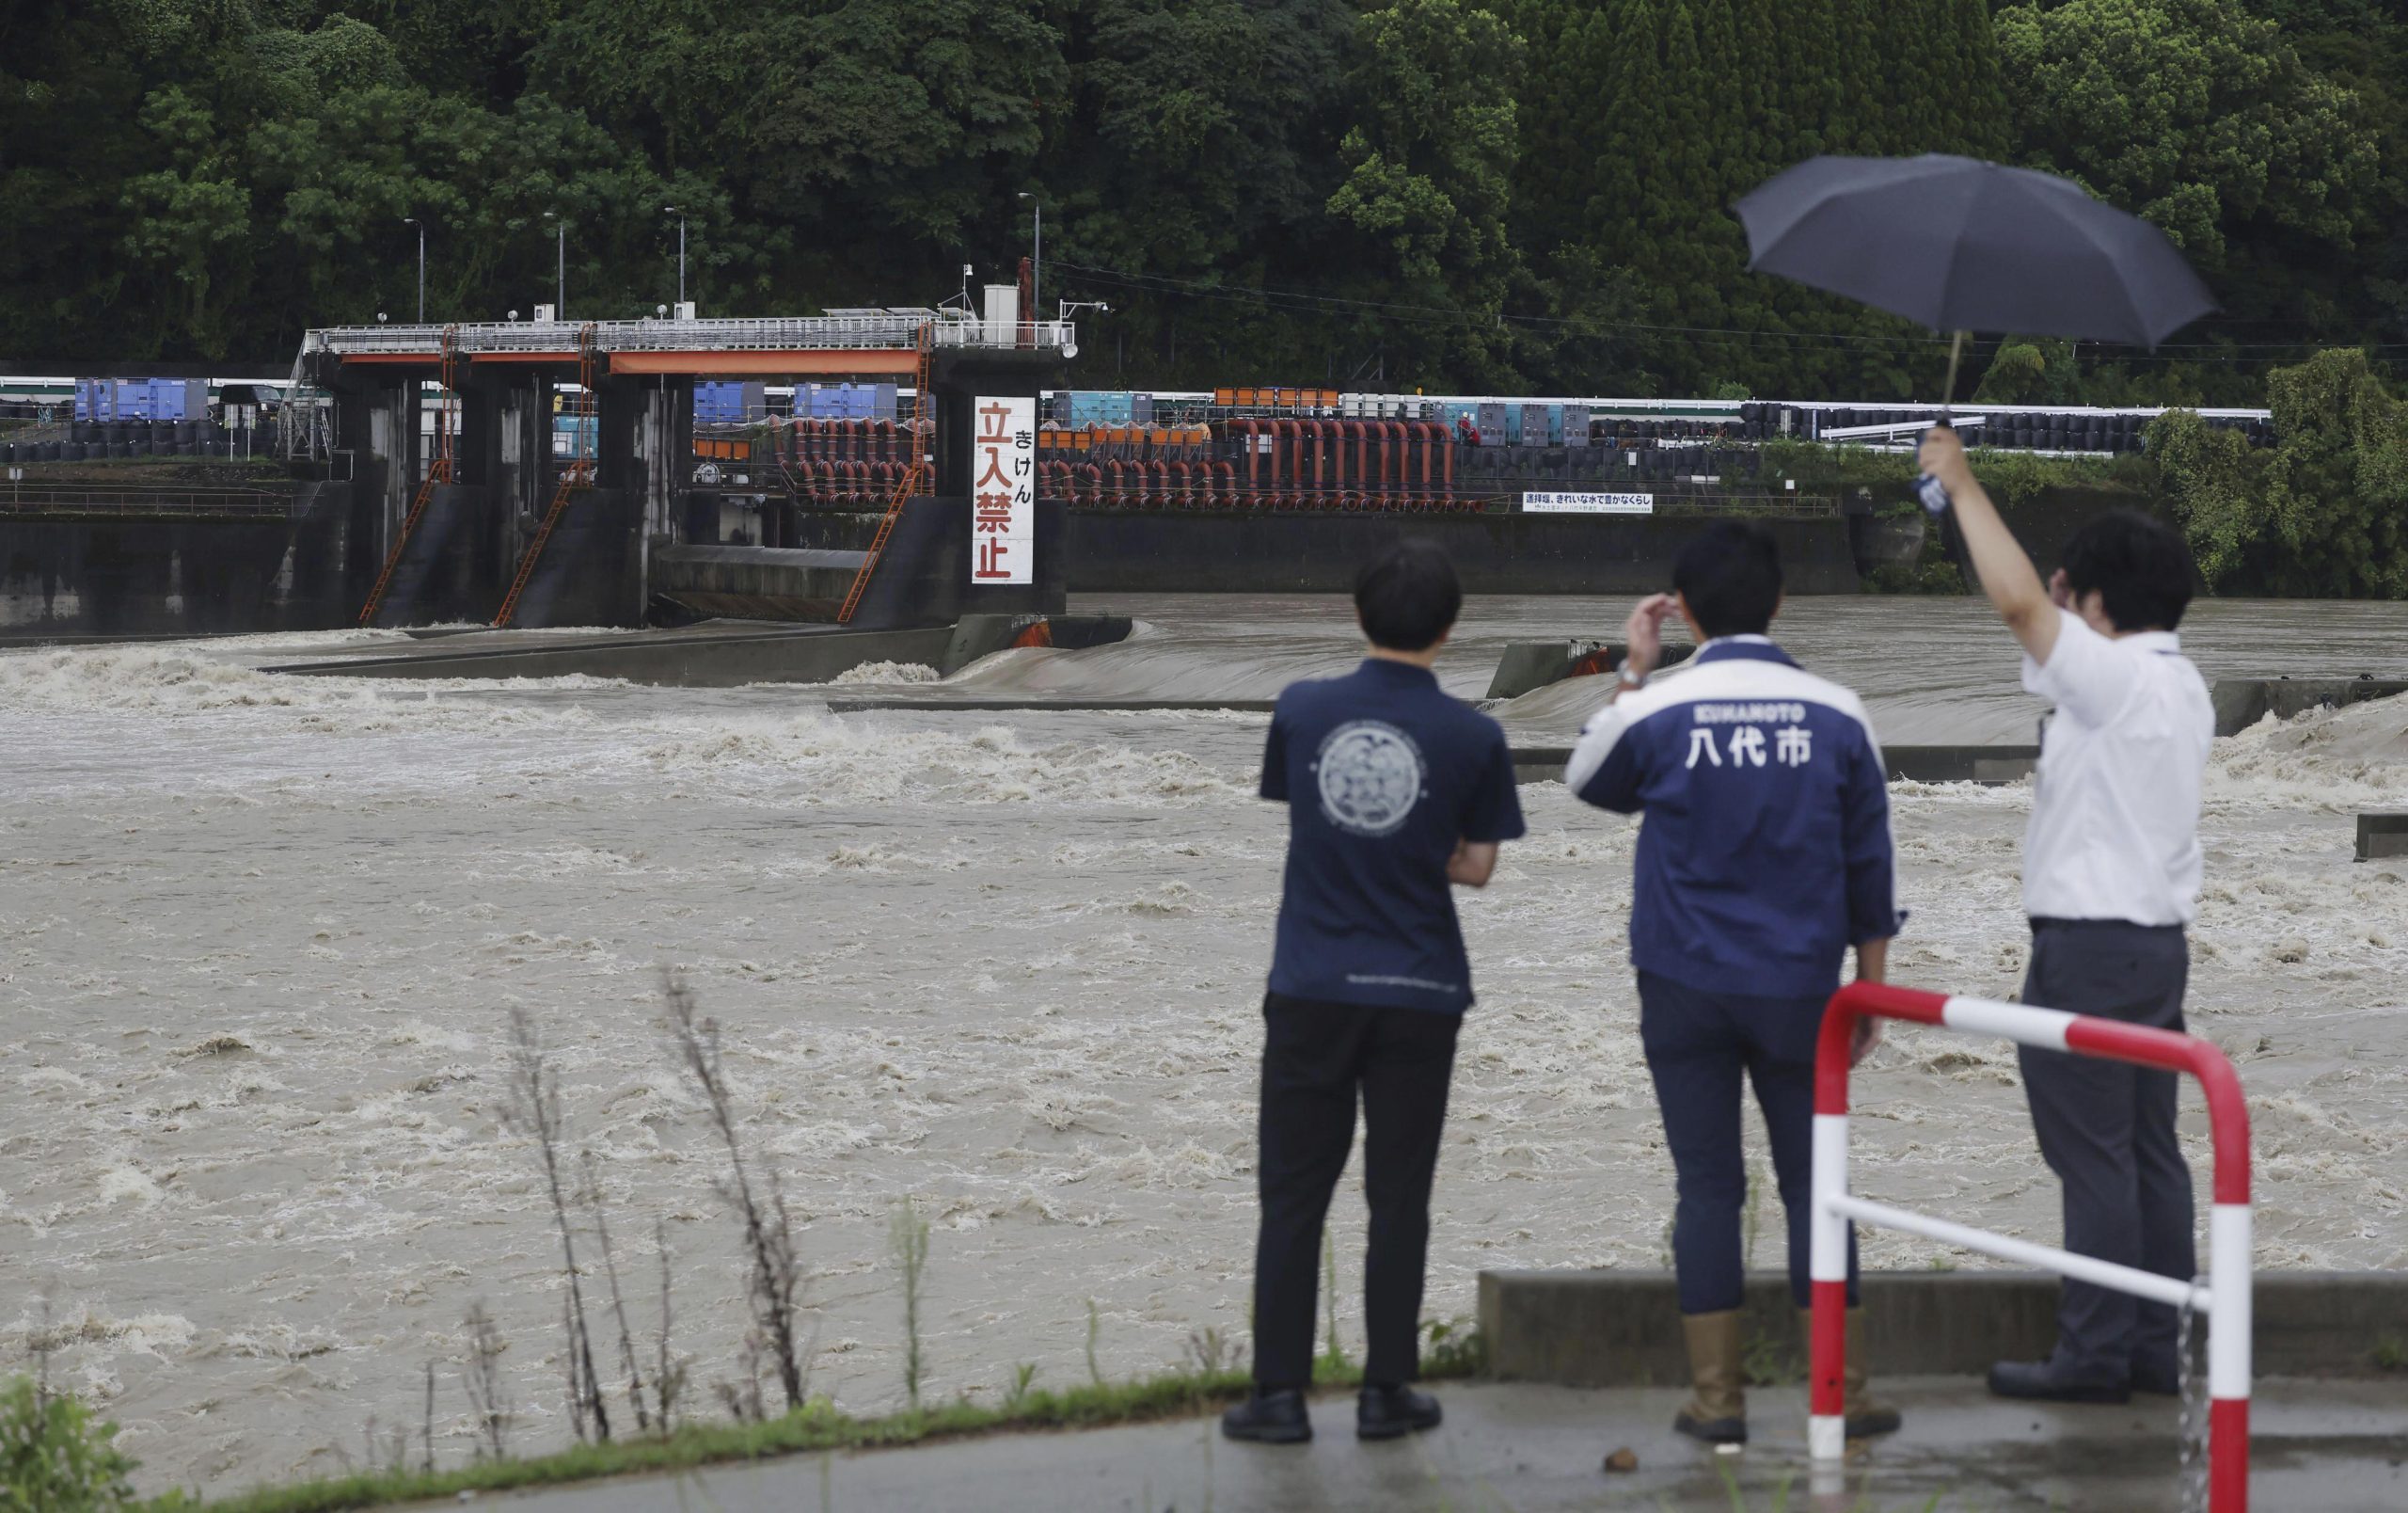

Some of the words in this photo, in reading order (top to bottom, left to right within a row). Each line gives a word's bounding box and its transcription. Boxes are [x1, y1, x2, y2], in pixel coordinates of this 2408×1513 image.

[975, 401, 1013, 578] 立入禁止
[1015, 429, 1033, 504] きけん
[1694, 703, 1806, 724] KUMAMOTO
[1685, 725, 1813, 770] 八代市
